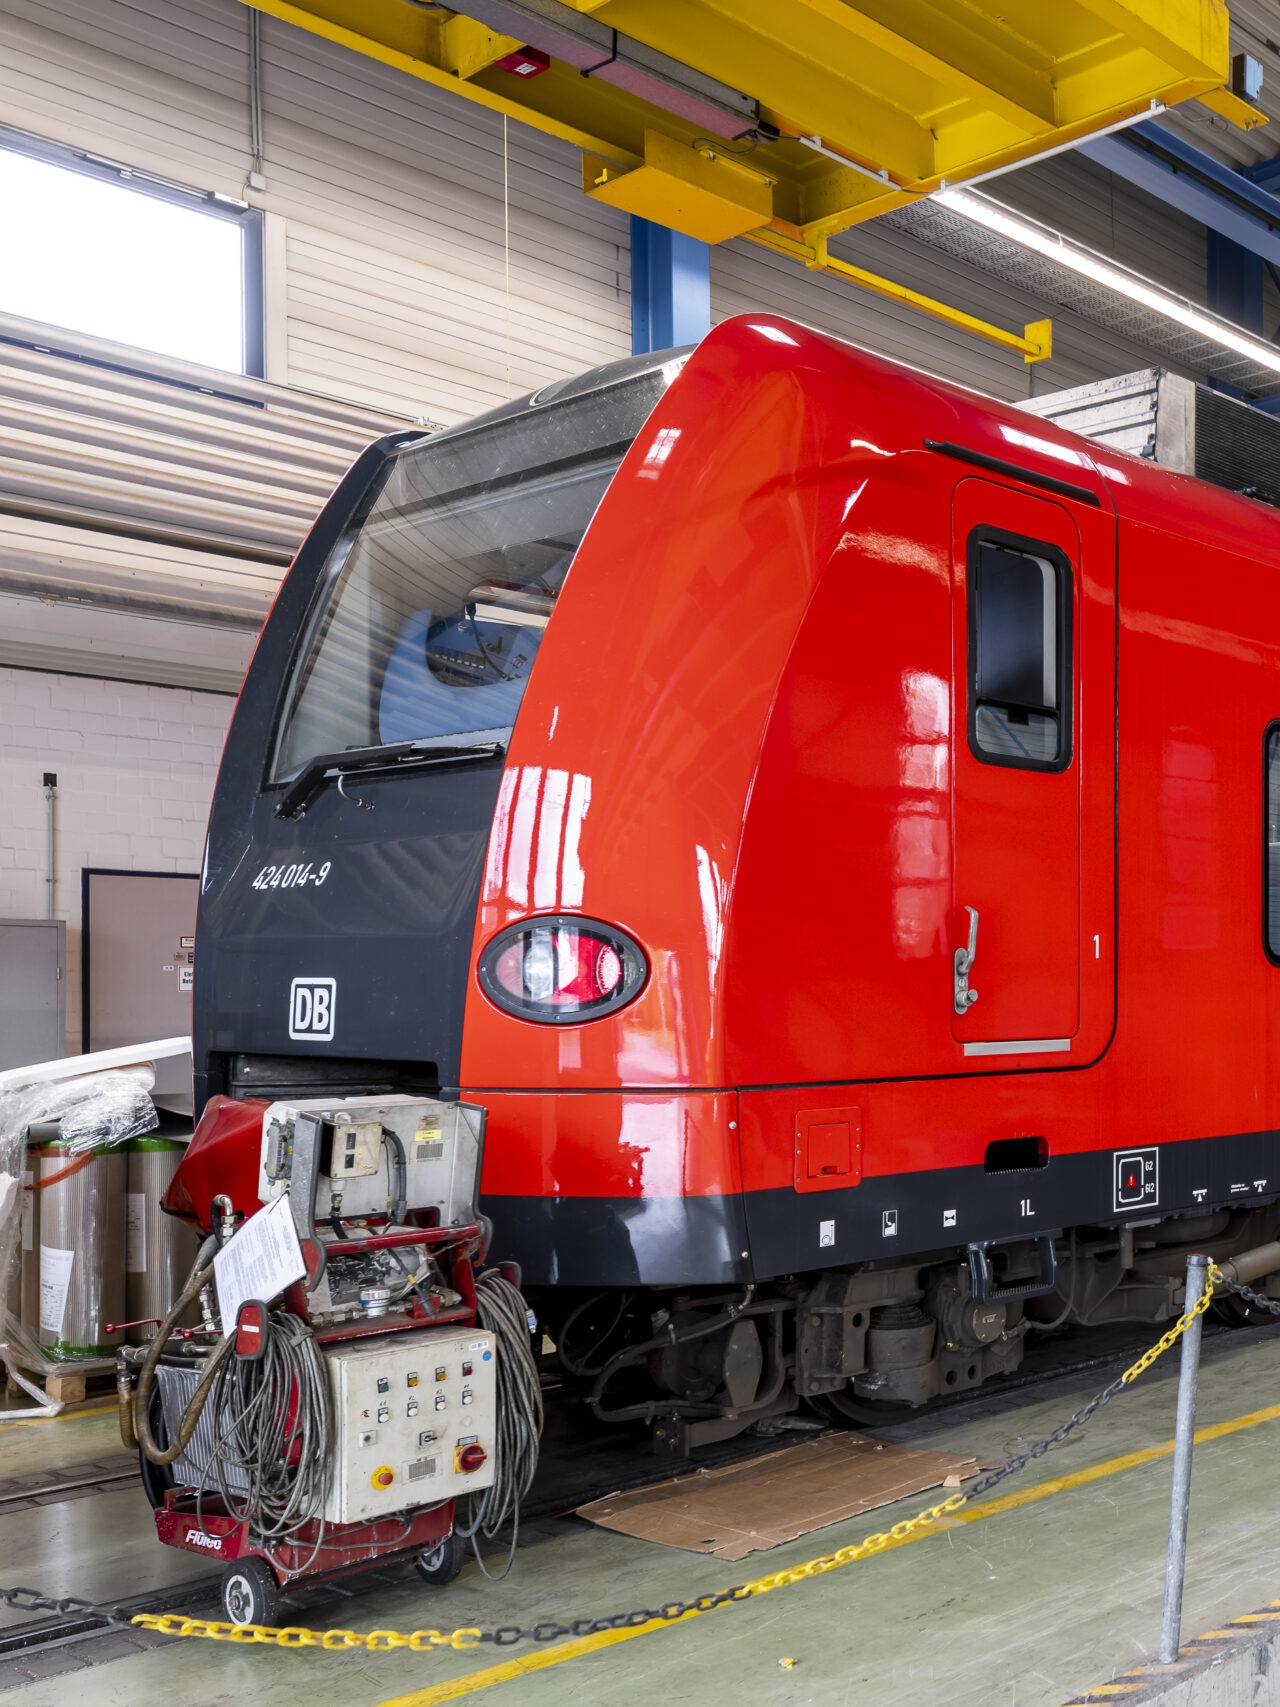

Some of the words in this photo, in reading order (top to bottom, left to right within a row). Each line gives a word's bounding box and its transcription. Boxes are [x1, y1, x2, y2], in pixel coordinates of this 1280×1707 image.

[1093, 934, 1100, 959] 1
[293, 985, 332, 1032] DB
[1020, 1198, 1035, 1217] 1L
